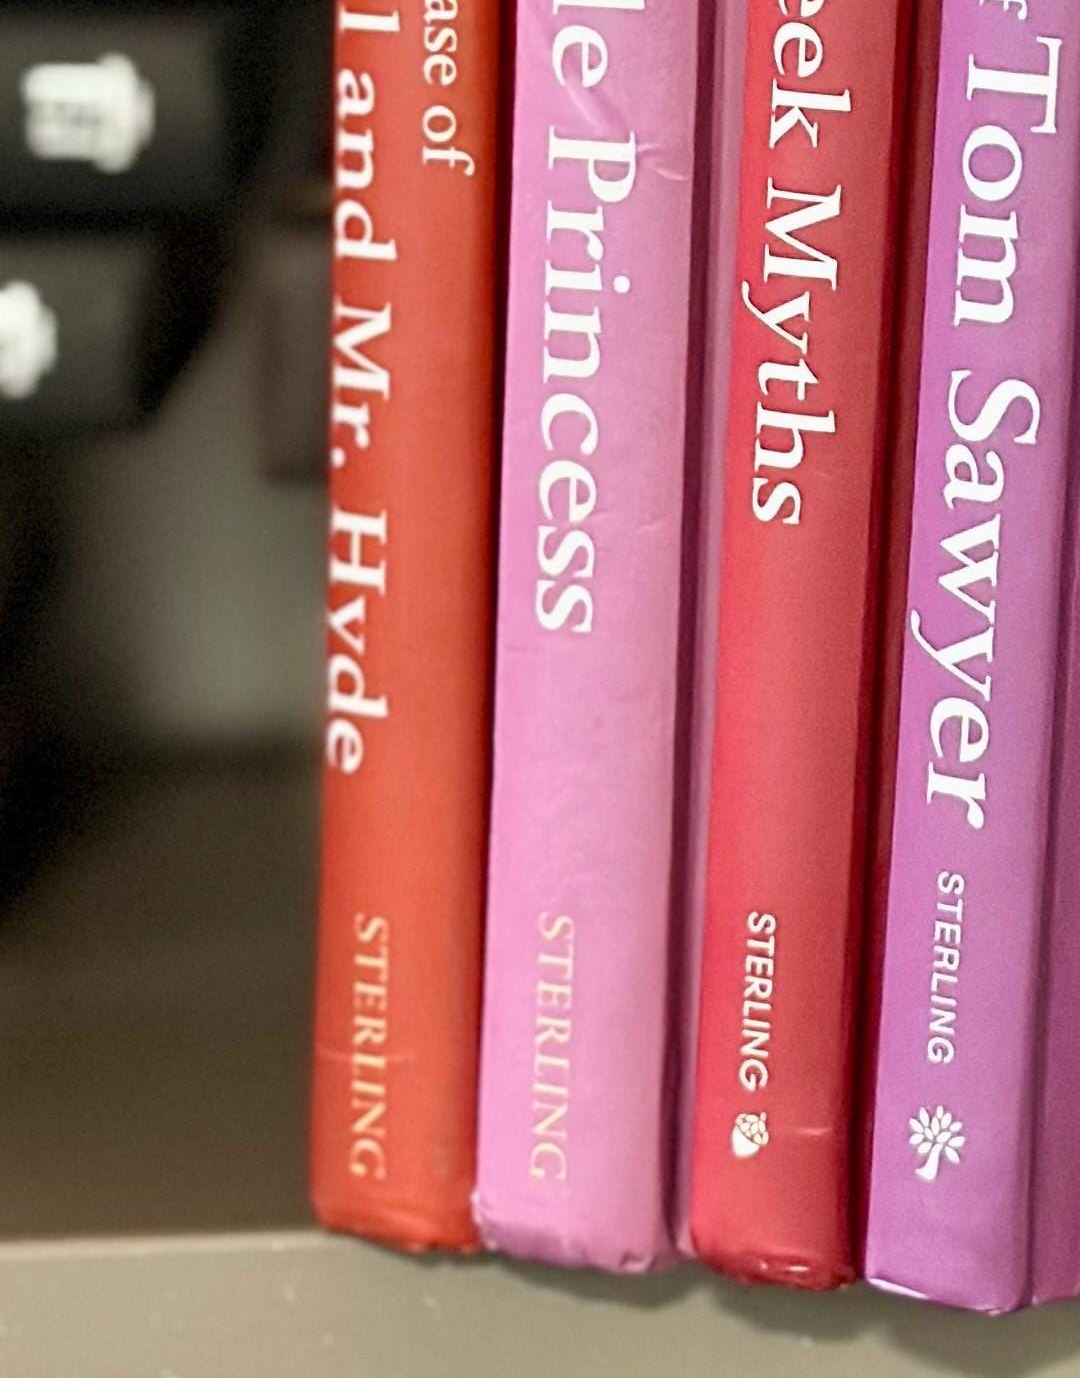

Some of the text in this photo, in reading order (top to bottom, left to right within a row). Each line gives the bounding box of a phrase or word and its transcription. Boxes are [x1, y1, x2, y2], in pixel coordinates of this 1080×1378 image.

[331, 72, 397, 262] and
[422, 105, 473, 176] of
[953, 36, 1063, 328] Tom
[329, 301, 391, 470] Mr.
[533, 125, 643, 636] Princess
[739, 175, 842, 527] Myths
[324, 508, 389, 776] Hyde
[910, 369, 1042, 831] Sawyer
[350, 913, 390, 1179] STERLING
[528, 912, 576, 1182] STERLING
[736, 909, 778, 1094] STERLING
[925, 868, 967, 1067] STERLING
